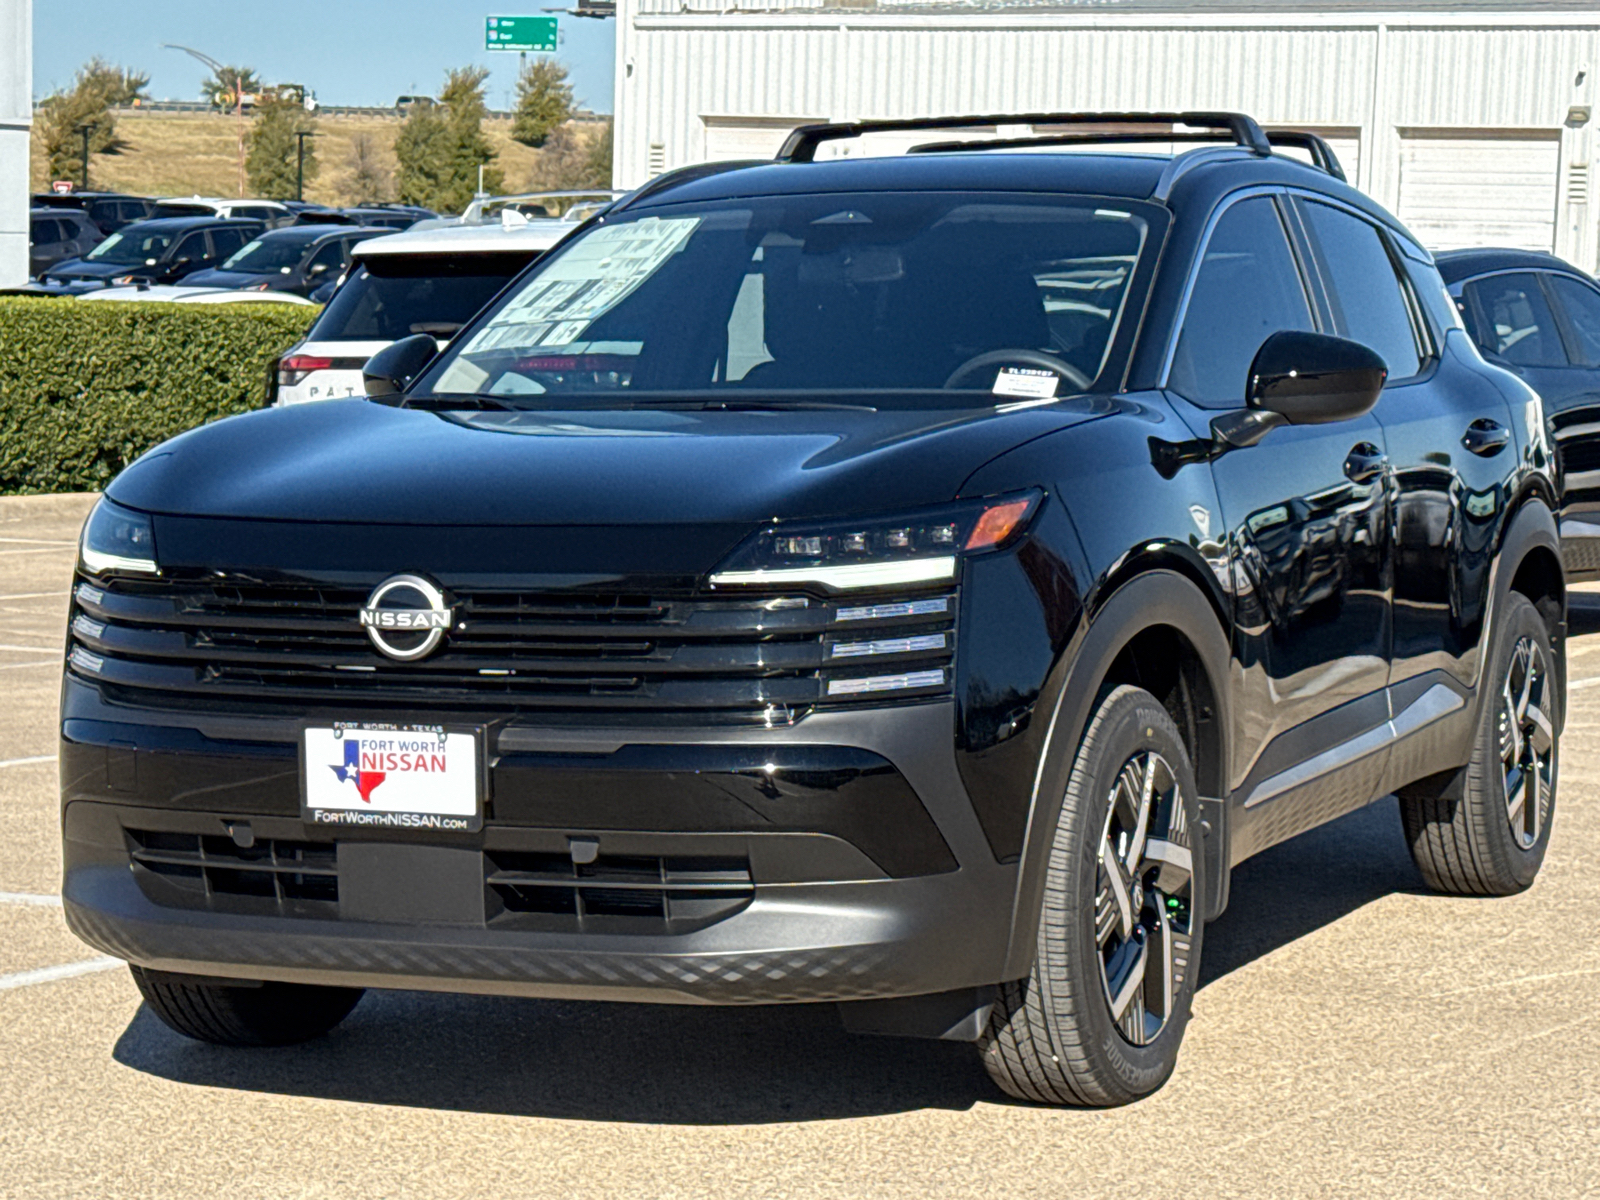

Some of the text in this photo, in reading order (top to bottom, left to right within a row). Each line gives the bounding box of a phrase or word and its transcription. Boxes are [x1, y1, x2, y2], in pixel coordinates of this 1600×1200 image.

[360, 609, 450, 627] NISSAN
[333, 721, 444, 733] FORT WORTH TEXAS
[361, 740, 446, 753] FORT WORTH
[362, 752, 446, 773] NISSAN
